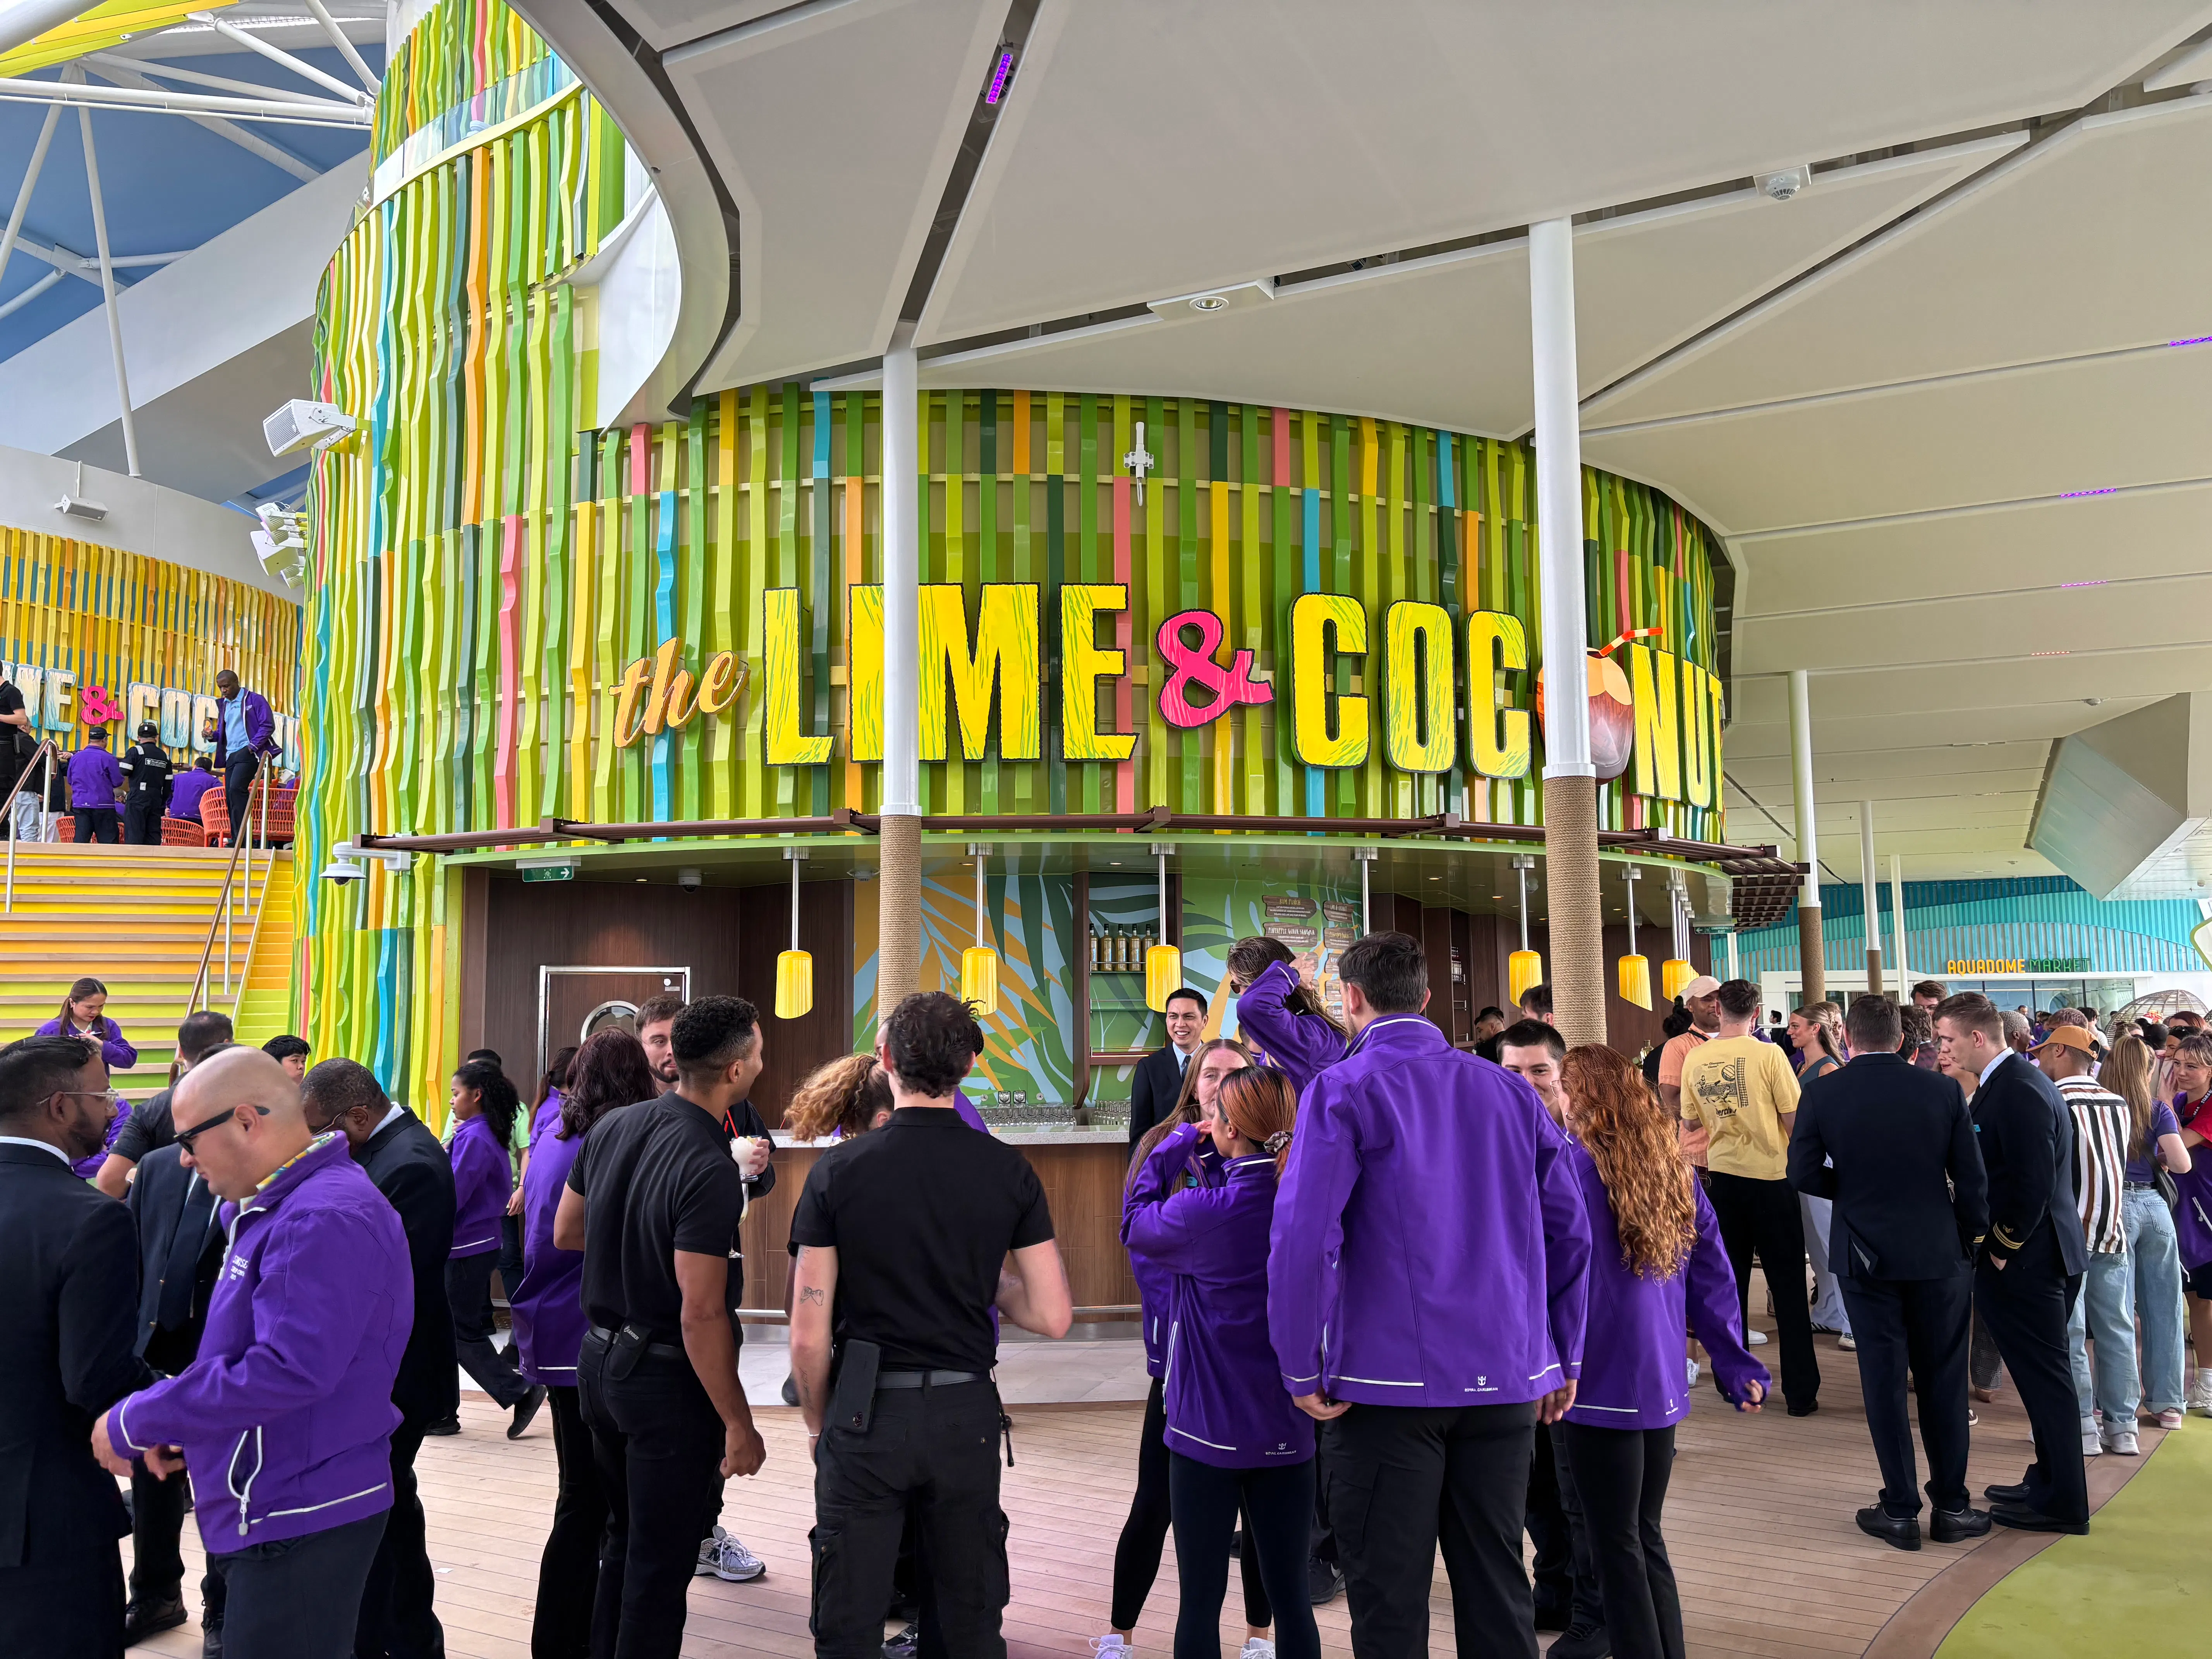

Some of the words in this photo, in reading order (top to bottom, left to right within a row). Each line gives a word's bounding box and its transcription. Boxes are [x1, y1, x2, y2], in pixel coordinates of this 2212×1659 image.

[608, 636, 750, 749] the
[763, 582, 1139, 766] LIME
[1155, 608, 1275, 730] &
[81, 685, 125, 725] &
[1947, 958, 2025, 977] AQUADOME
[2029, 957, 2090, 972] MARKET
